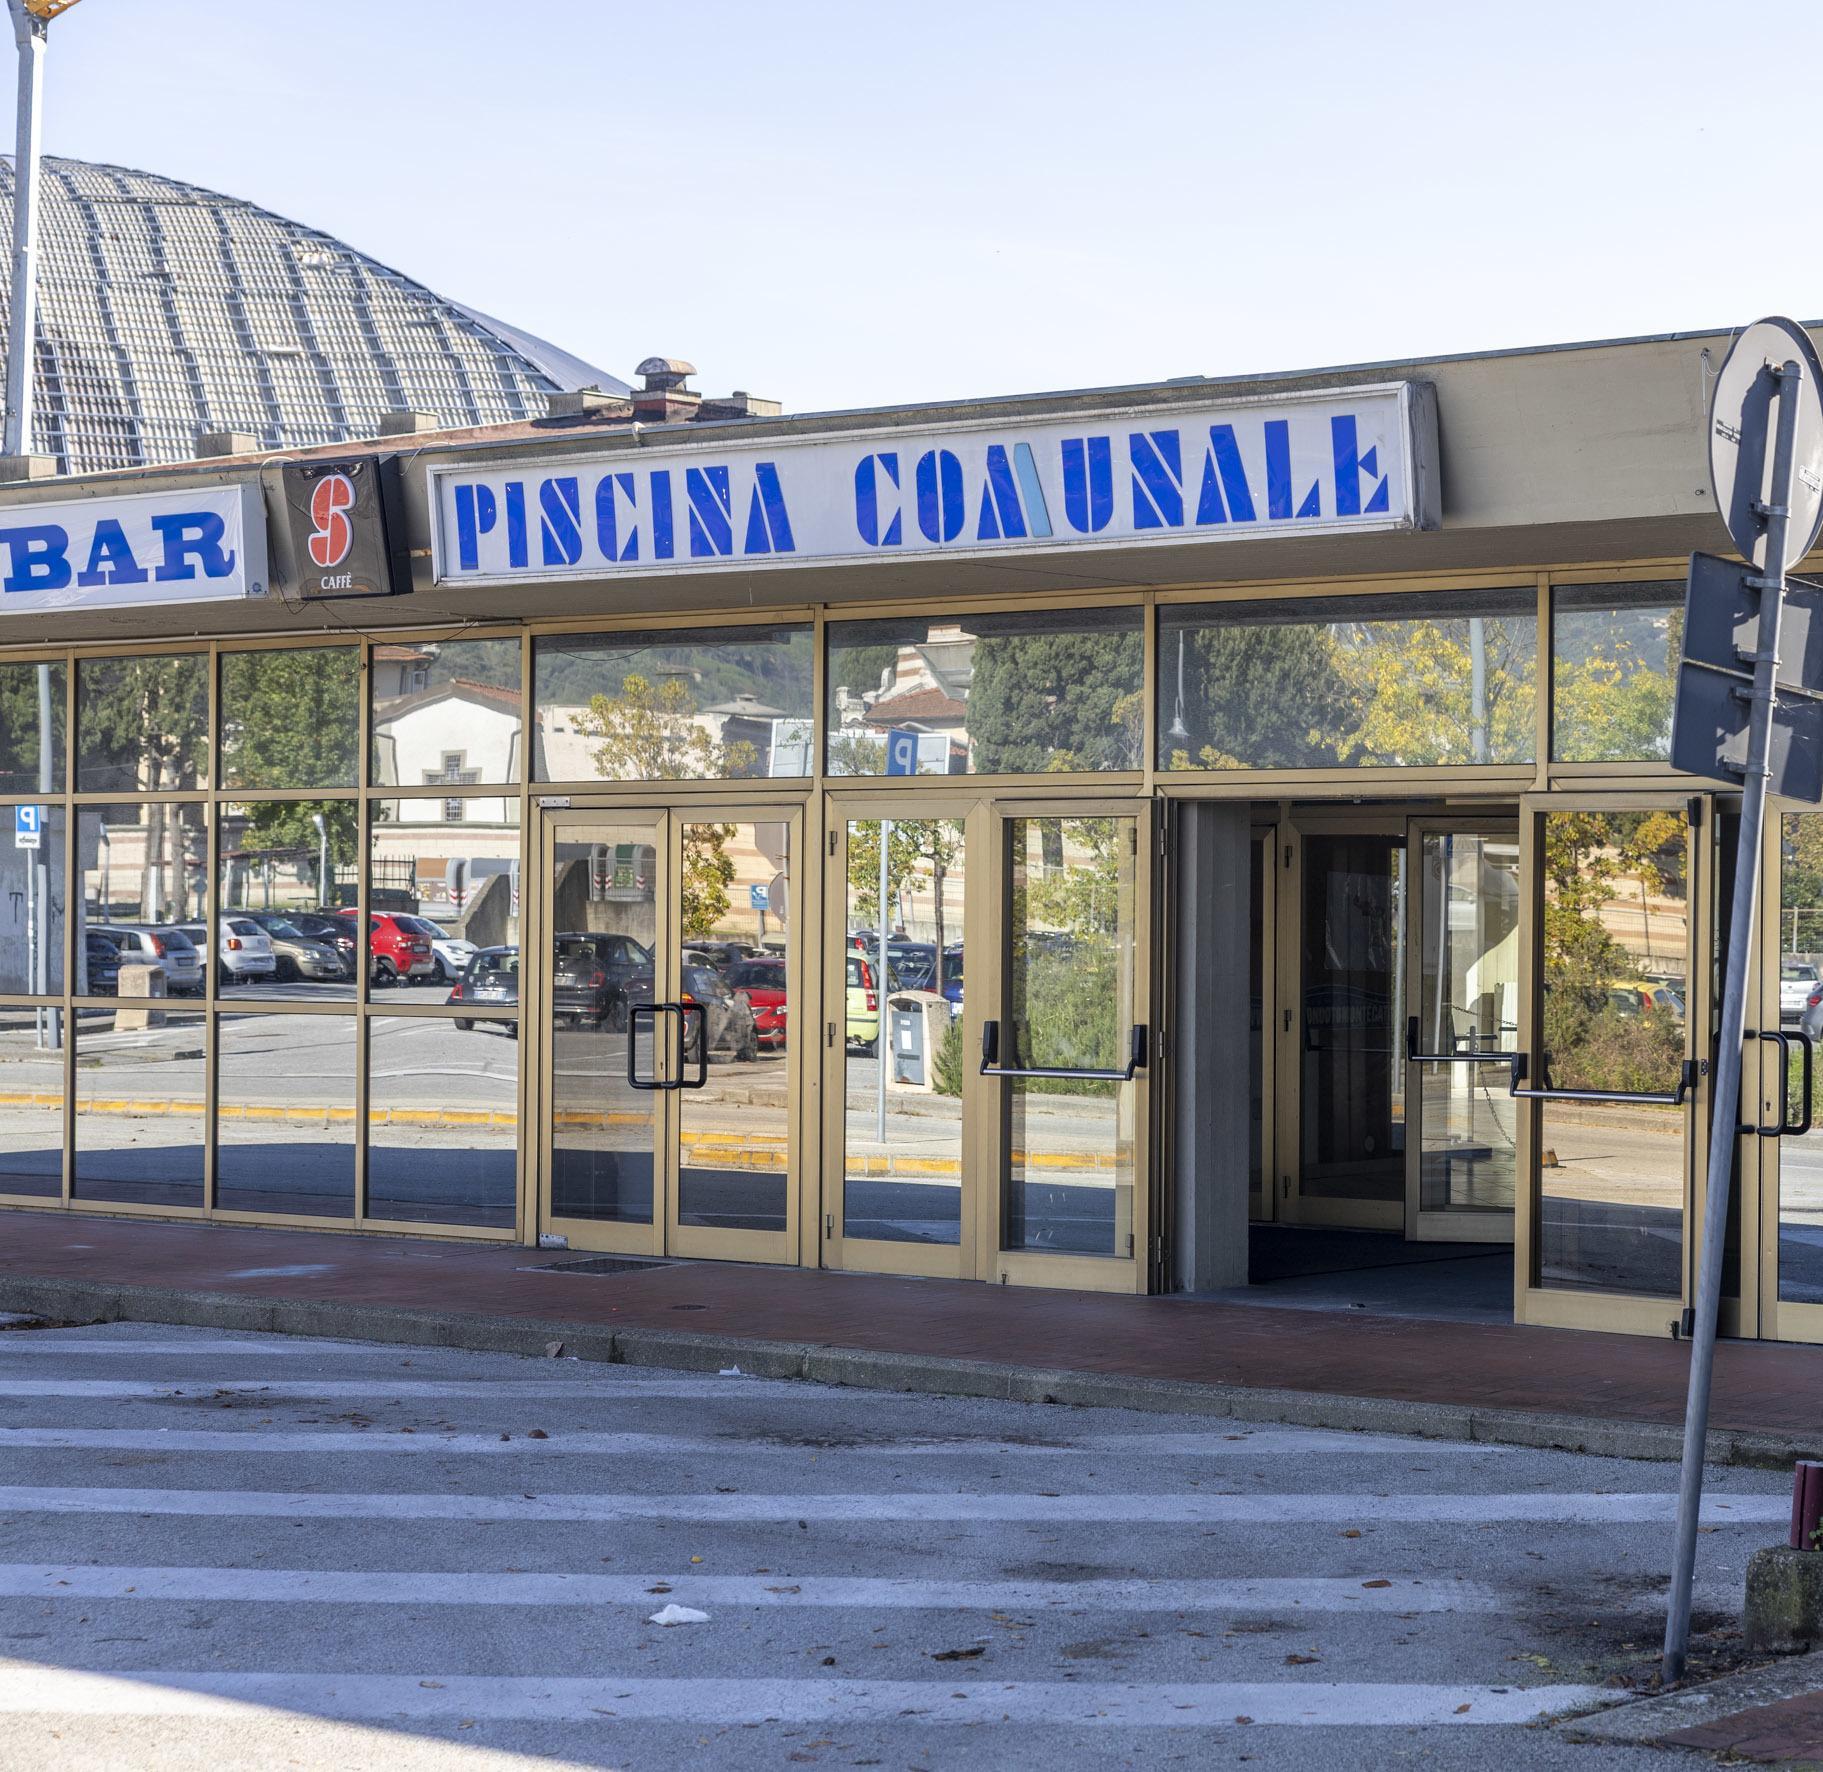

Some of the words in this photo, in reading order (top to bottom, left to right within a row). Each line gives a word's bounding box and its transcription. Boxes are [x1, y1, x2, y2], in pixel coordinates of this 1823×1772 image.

[454, 463, 797, 571] PISCINA
[853, 415, 1390, 546] COMUNALE
[0, 511, 236, 593] BAR
[320, 571, 352, 589] CAFFÈ
